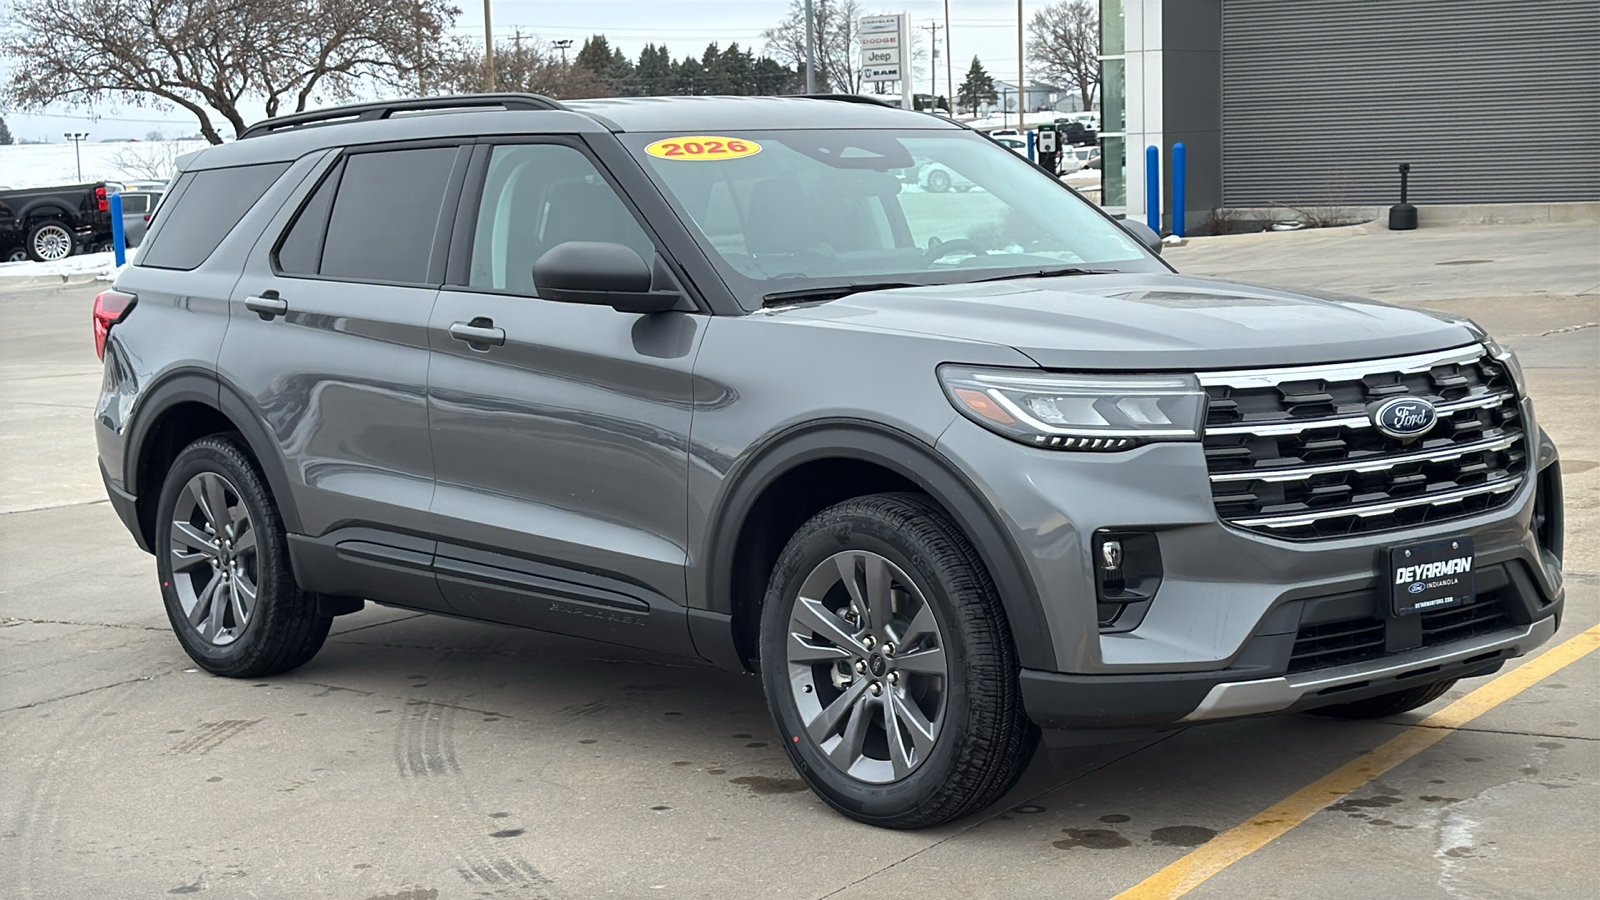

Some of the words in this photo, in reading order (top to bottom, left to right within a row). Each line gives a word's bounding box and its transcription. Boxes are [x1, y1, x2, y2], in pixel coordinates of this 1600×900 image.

[868, 51, 892, 62] Jeep
[661, 140, 749, 157] 2026
[1394, 405, 1427, 428] Ford
[1395, 556, 1473, 585] DEYARMAN
[1426, 578, 1459, 589] INDIANOLA
[549, 602, 646, 627] EXPLORER
